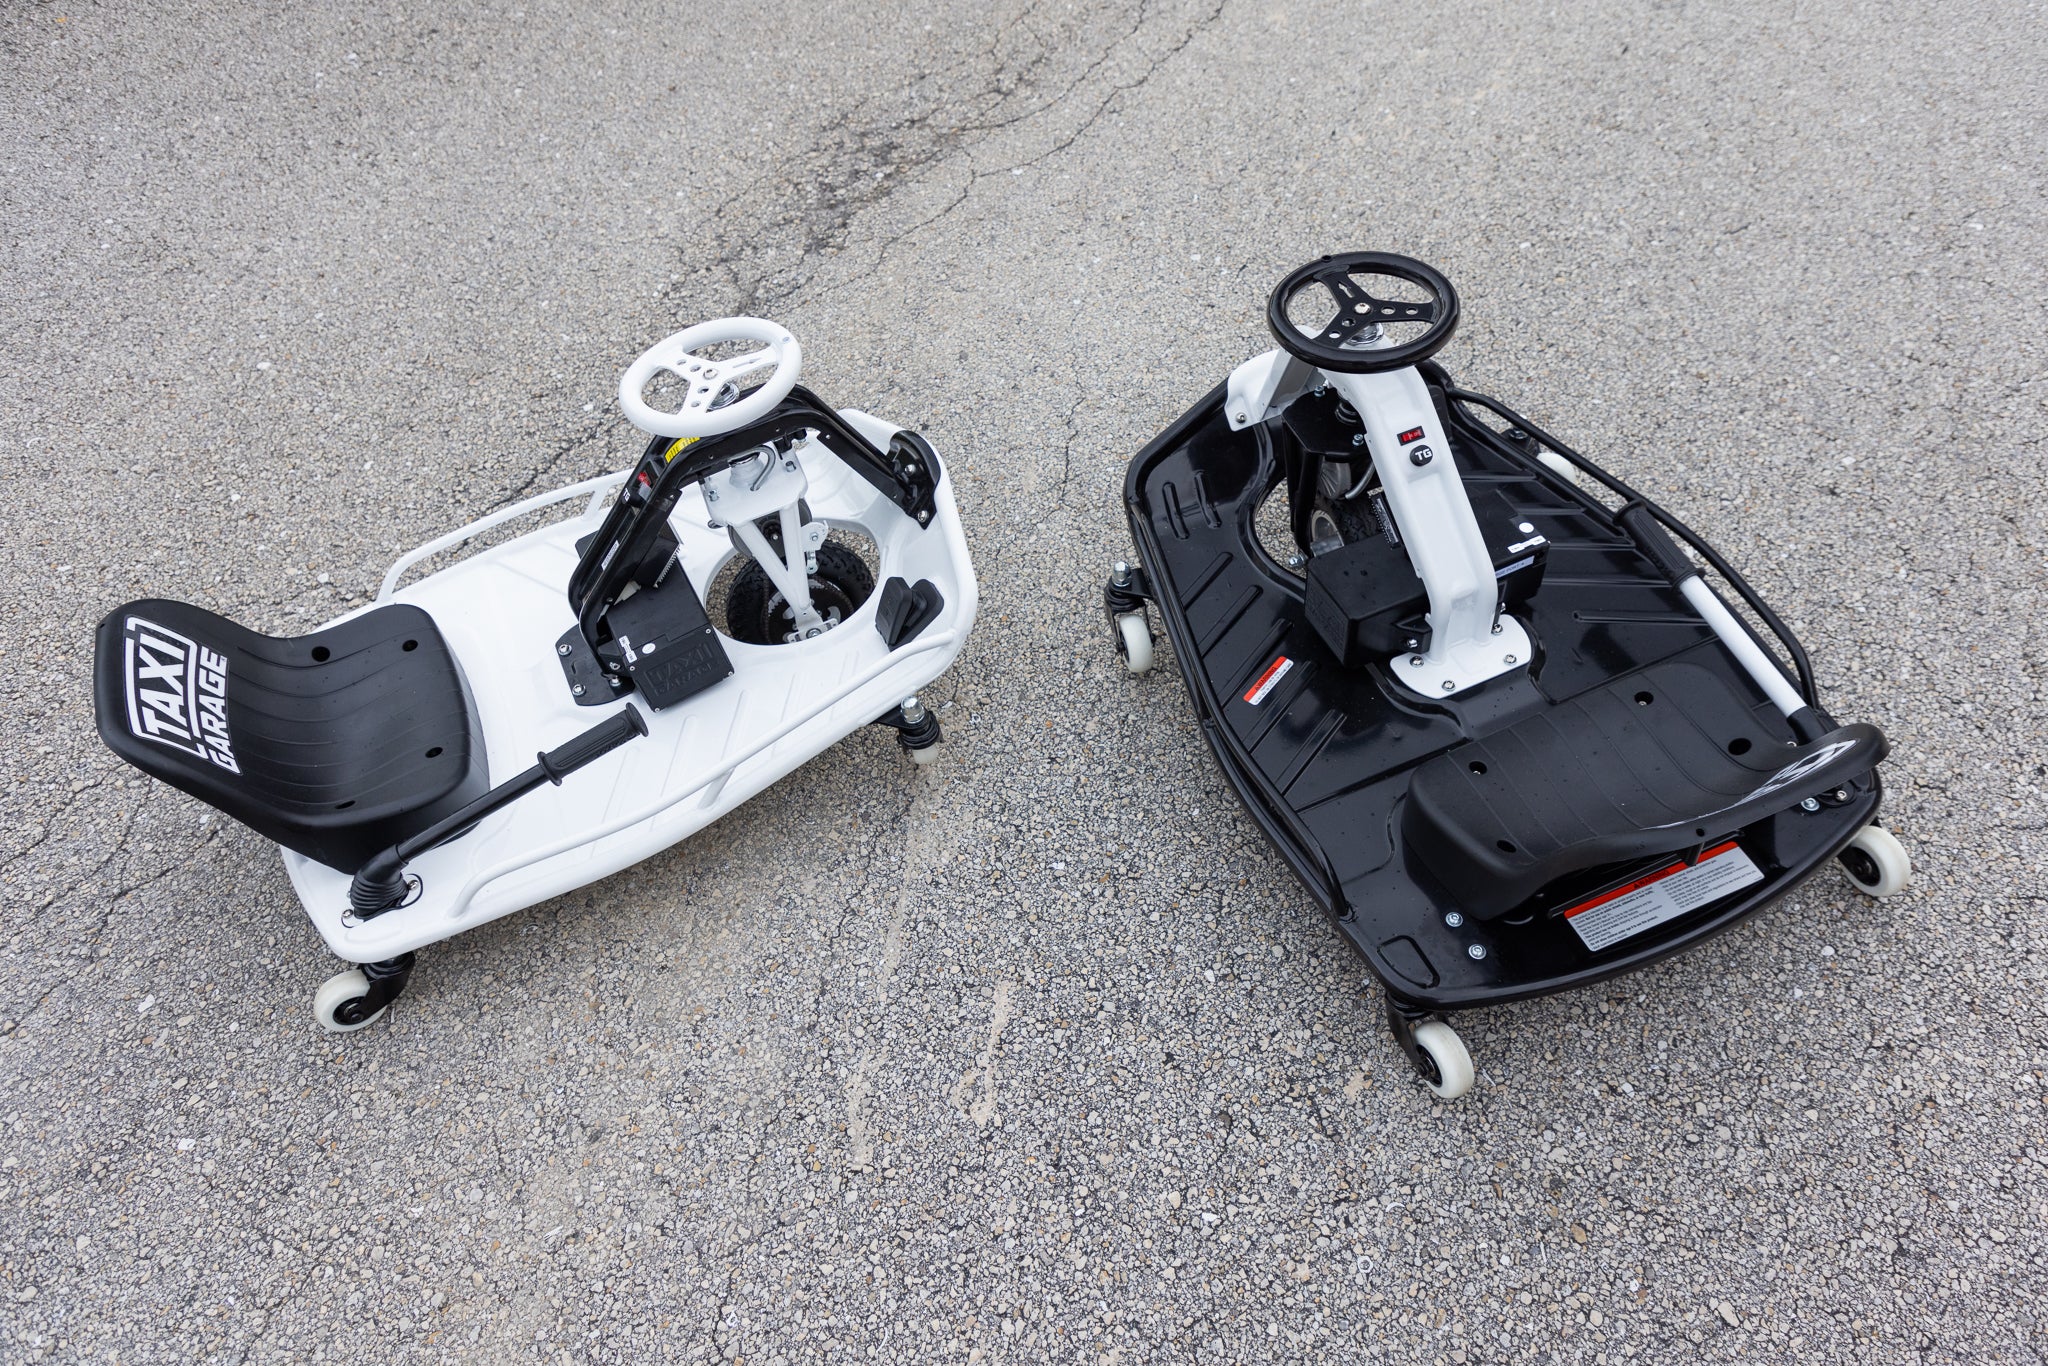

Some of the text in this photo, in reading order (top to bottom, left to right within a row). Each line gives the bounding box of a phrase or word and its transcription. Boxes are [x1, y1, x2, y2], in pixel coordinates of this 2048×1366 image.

[1415, 448, 1432, 460] TG
[139, 633, 192, 741] TAXI
[199, 646, 241, 774] GARAGE
